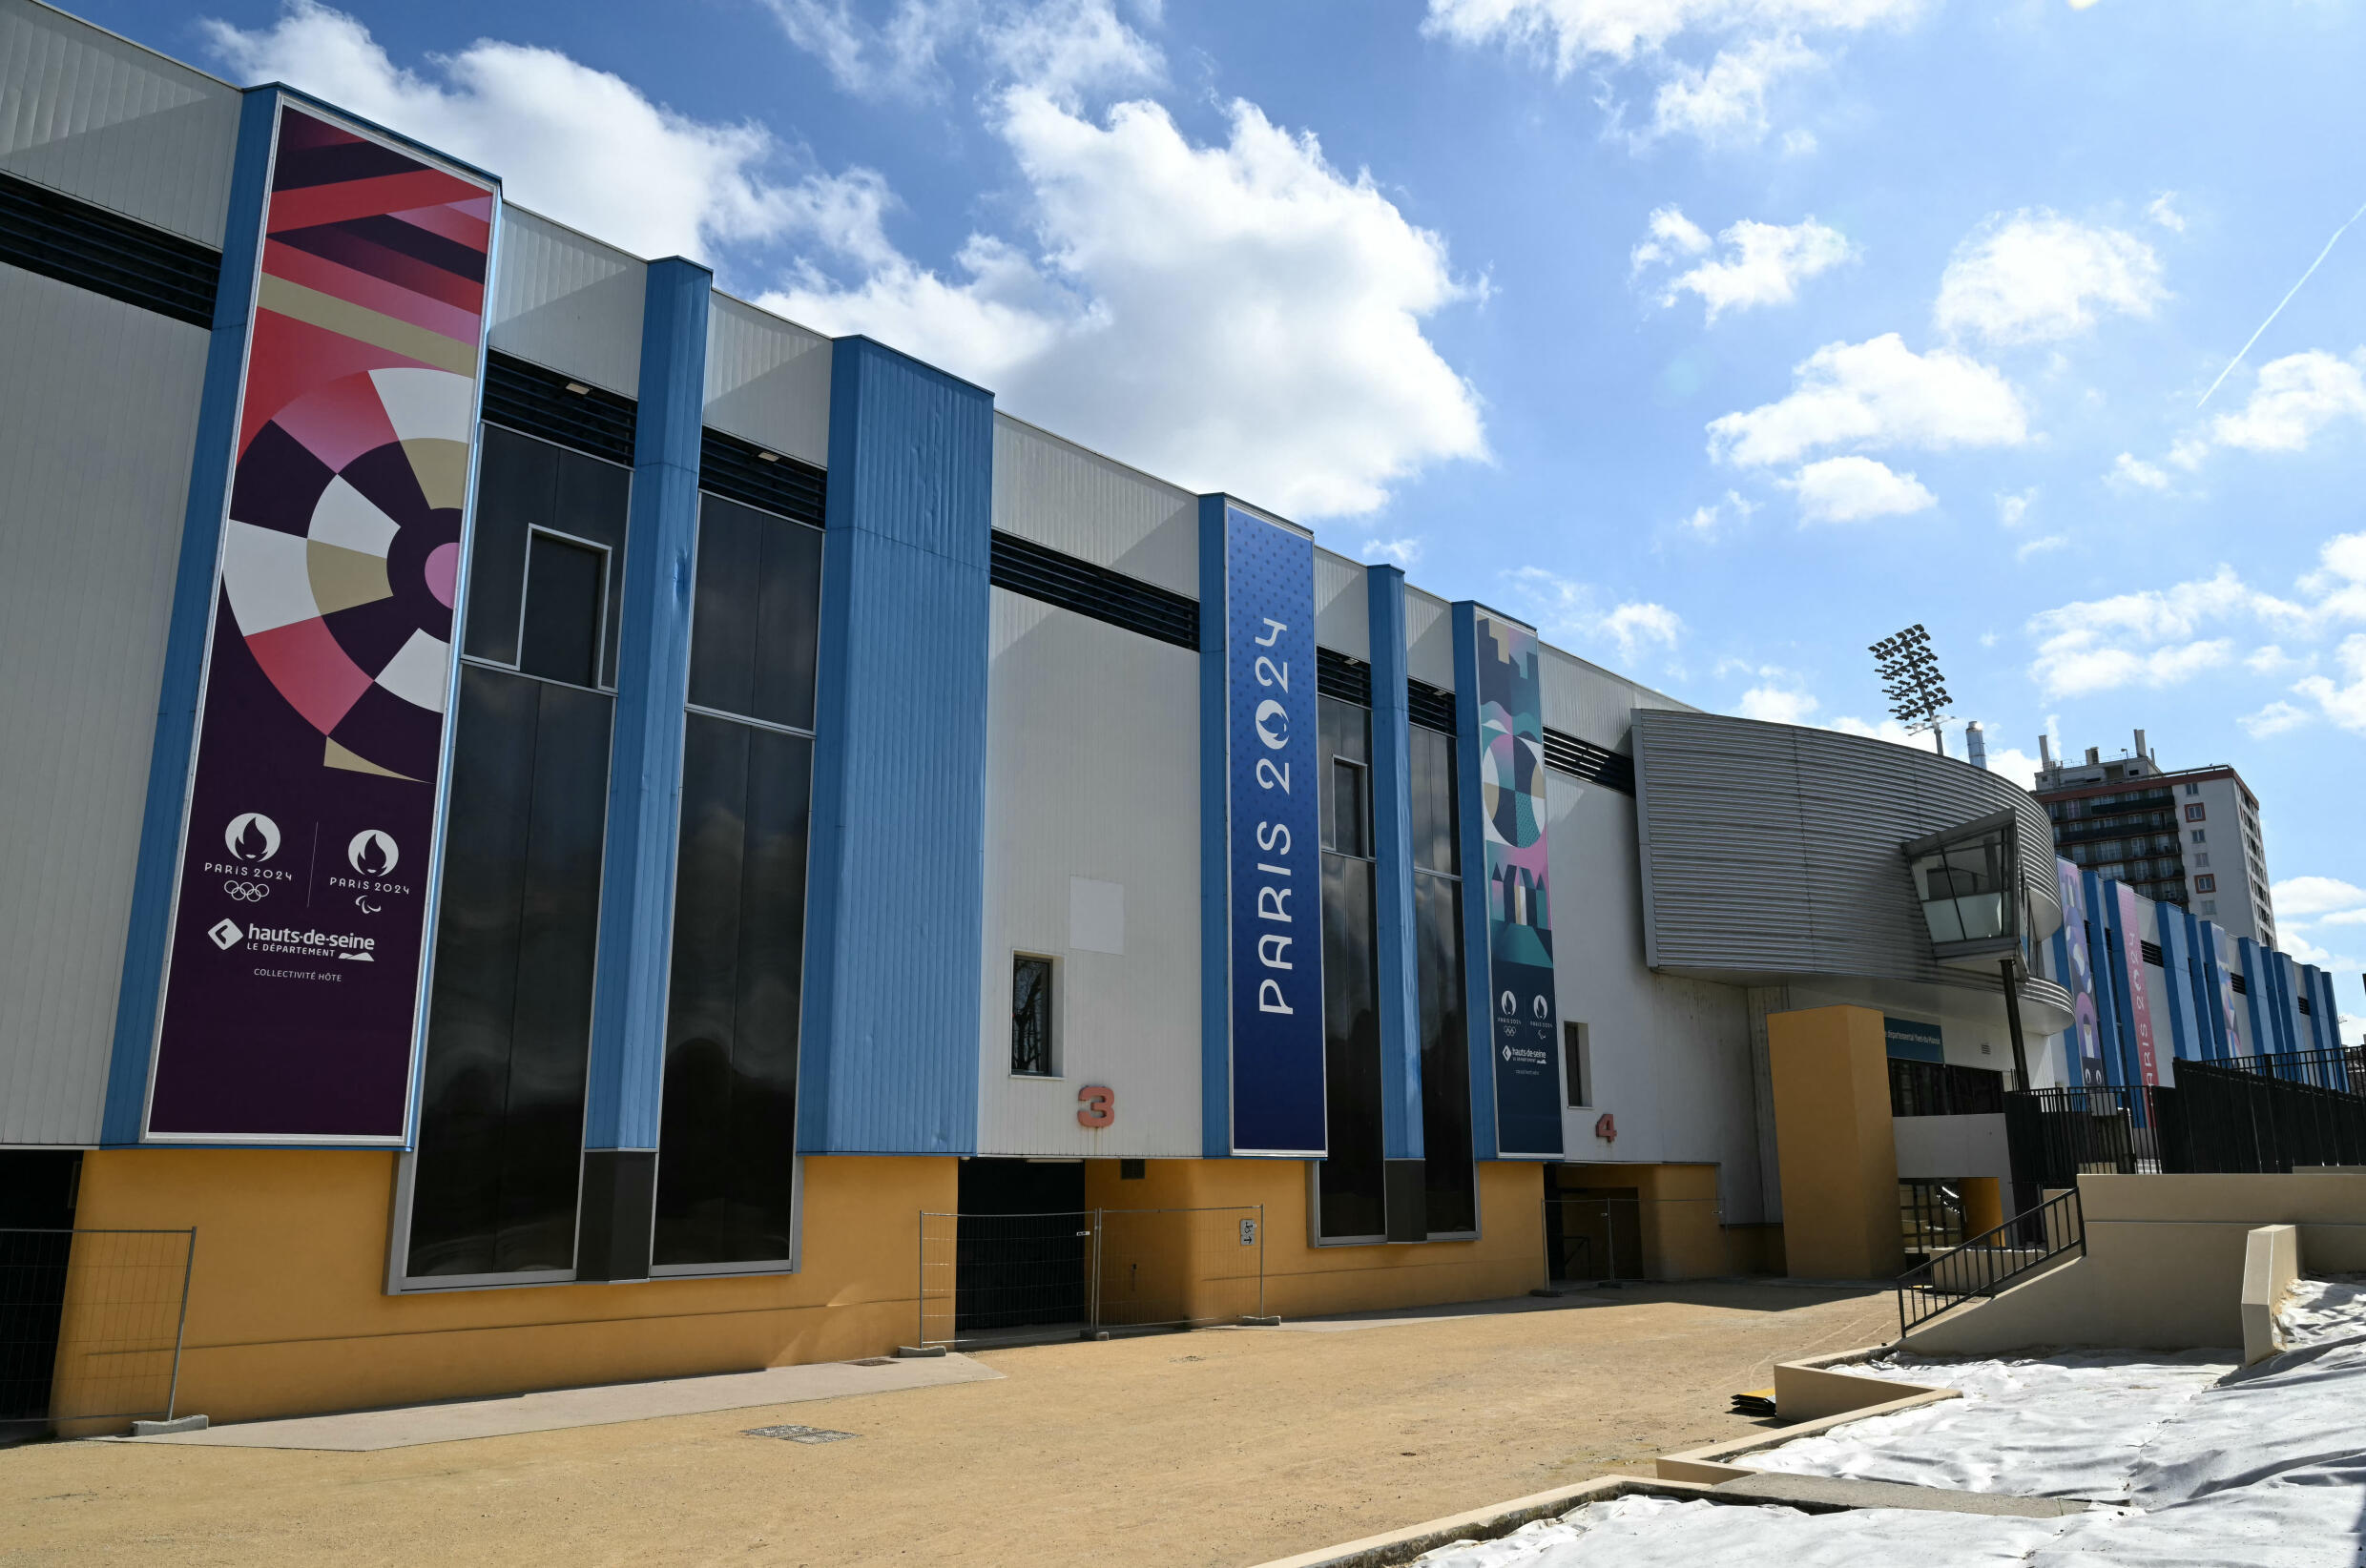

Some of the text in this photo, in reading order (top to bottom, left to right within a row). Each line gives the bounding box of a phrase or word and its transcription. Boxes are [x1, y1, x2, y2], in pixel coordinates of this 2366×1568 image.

[1255, 617, 1294, 1015] PARIS 2024
[204, 862, 292, 881] PARIS 2024
[329, 877, 410, 895] PARIS 2024
[248, 923, 375, 951] hauts-de-seine
[247, 941, 336, 958] LE DÉPARTEMENT
[254, 968, 342, 982] COLLECTIVITÉ HÔTE
[1077, 1086, 1114, 1127] 3
[1595, 1113, 1618, 1143] 4
